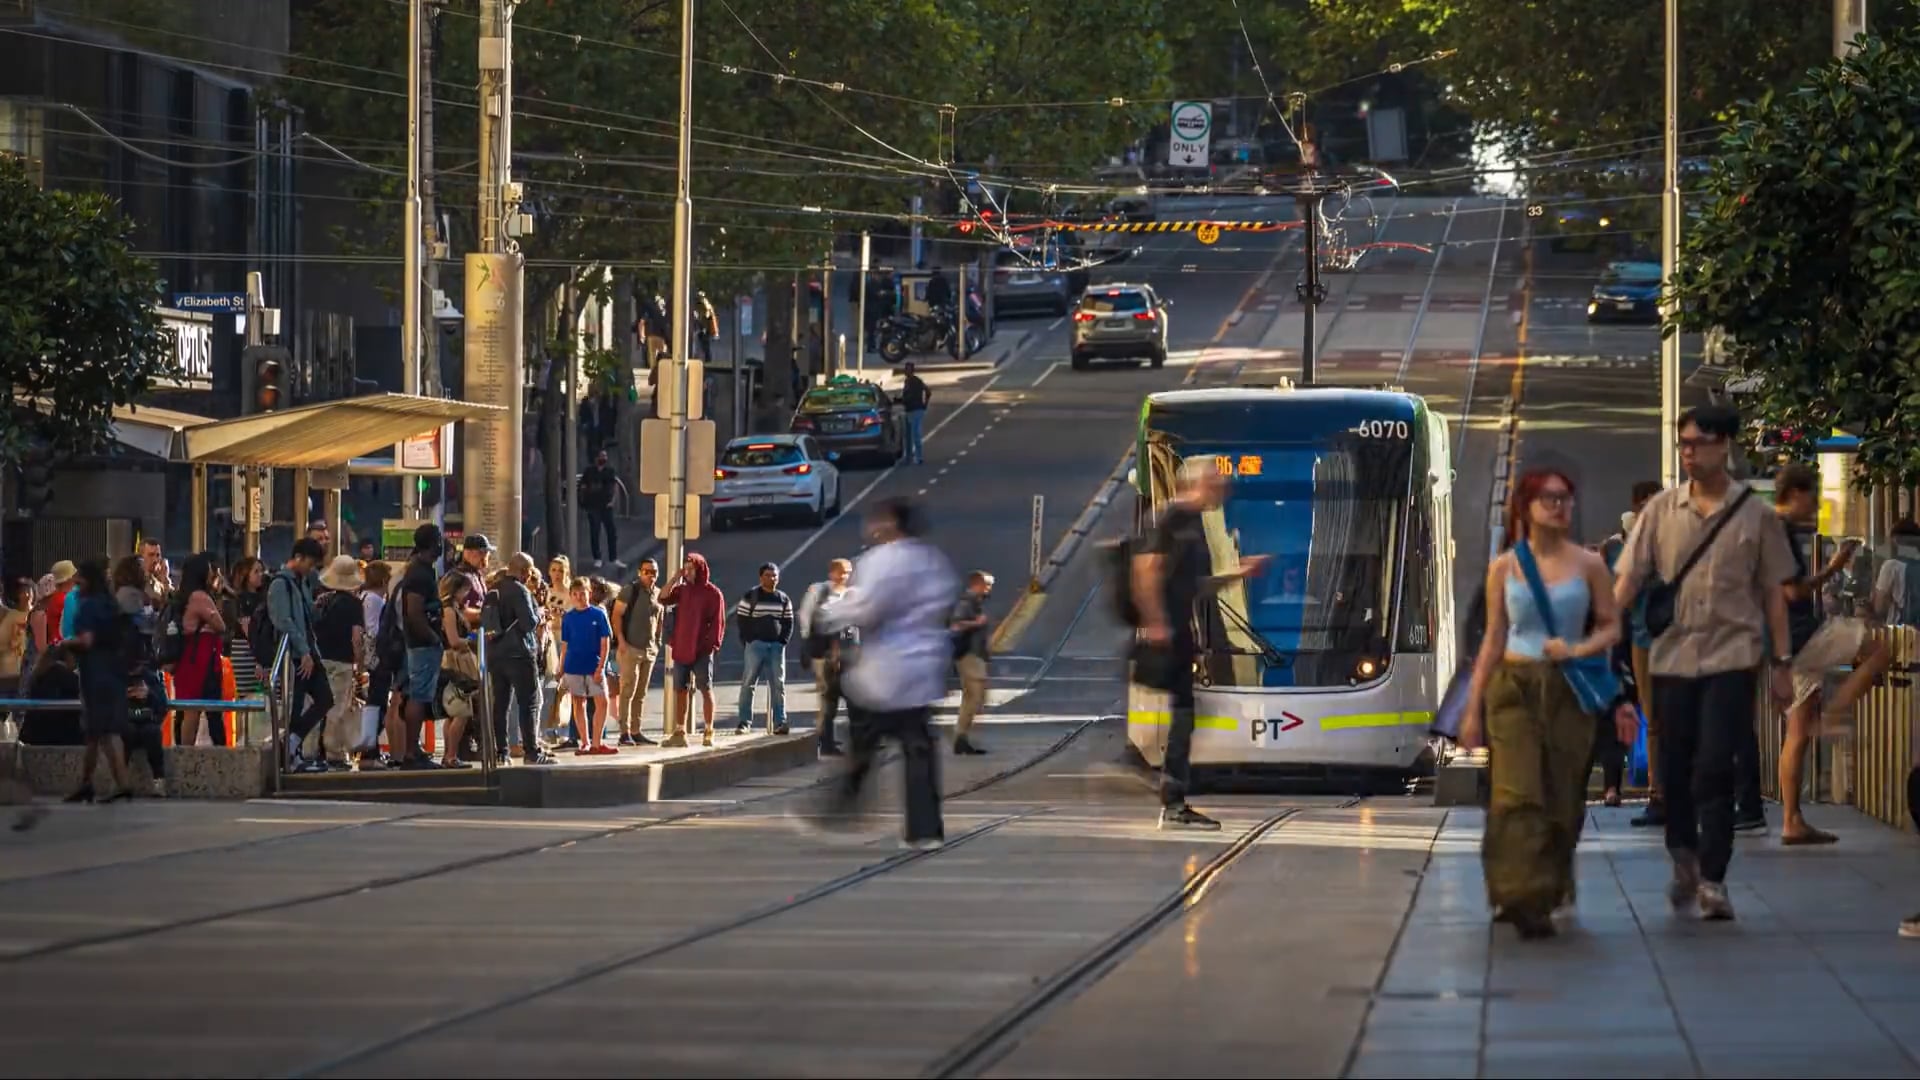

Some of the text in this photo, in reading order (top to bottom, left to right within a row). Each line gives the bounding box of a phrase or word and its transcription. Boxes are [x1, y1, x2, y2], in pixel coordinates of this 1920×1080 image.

[1172, 142, 1205, 153] ONLY
[1528, 205, 1543, 217] 33
[183, 295, 245, 307] Elizabeth St
[178, 324, 208, 376] OPTUS
[1358, 419, 1409, 439] 6070
